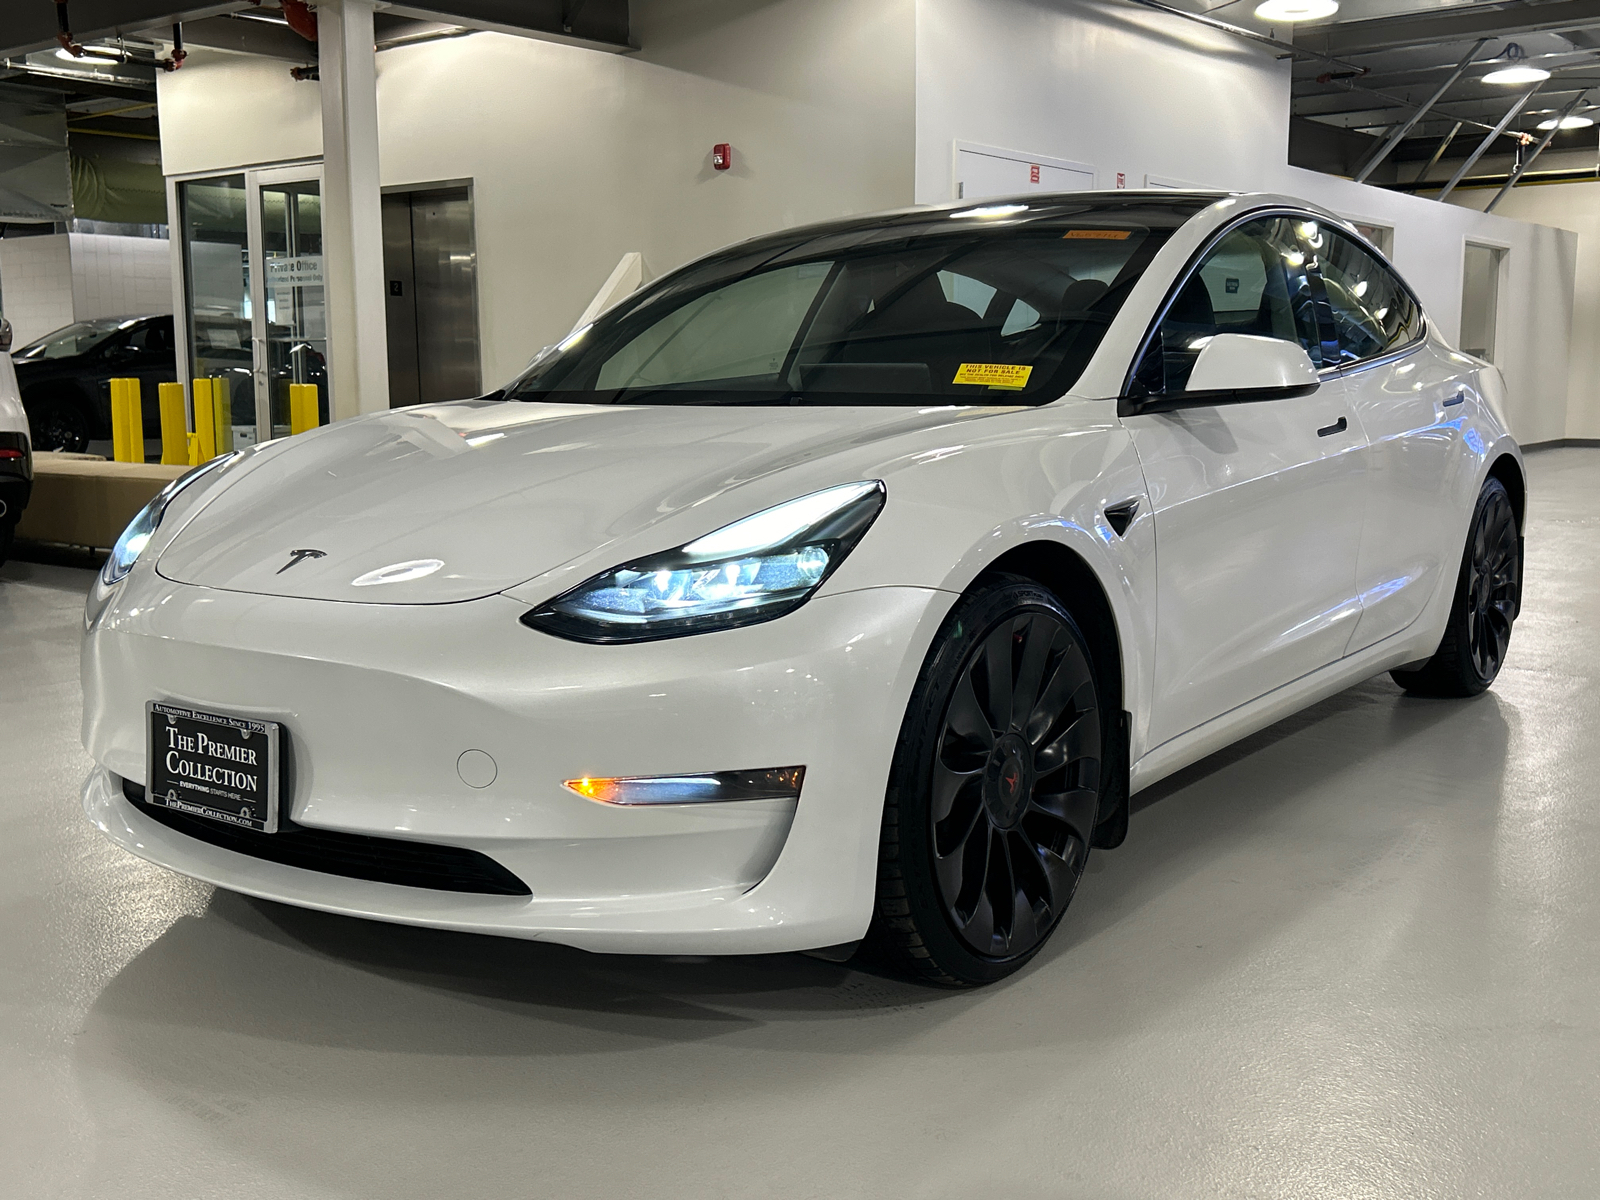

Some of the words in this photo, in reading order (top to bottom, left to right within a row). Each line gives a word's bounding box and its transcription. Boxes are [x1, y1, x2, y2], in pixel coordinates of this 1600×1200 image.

[297, 260, 317, 271] Office
[155, 704, 191, 718] AUTOMOTIVE
[192, 711, 228, 725] EXCELLENCE
[228, 718, 247, 728] SINCE
[248, 722, 265, 733] 1995
[166, 726, 195, 752] THE
[196, 732, 257, 766] PREMIER
[166, 750, 257, 792] COLLECTION
[180, 781, 210, 793] EVERYTHING
[210, 788, 228, 798] STARTS
